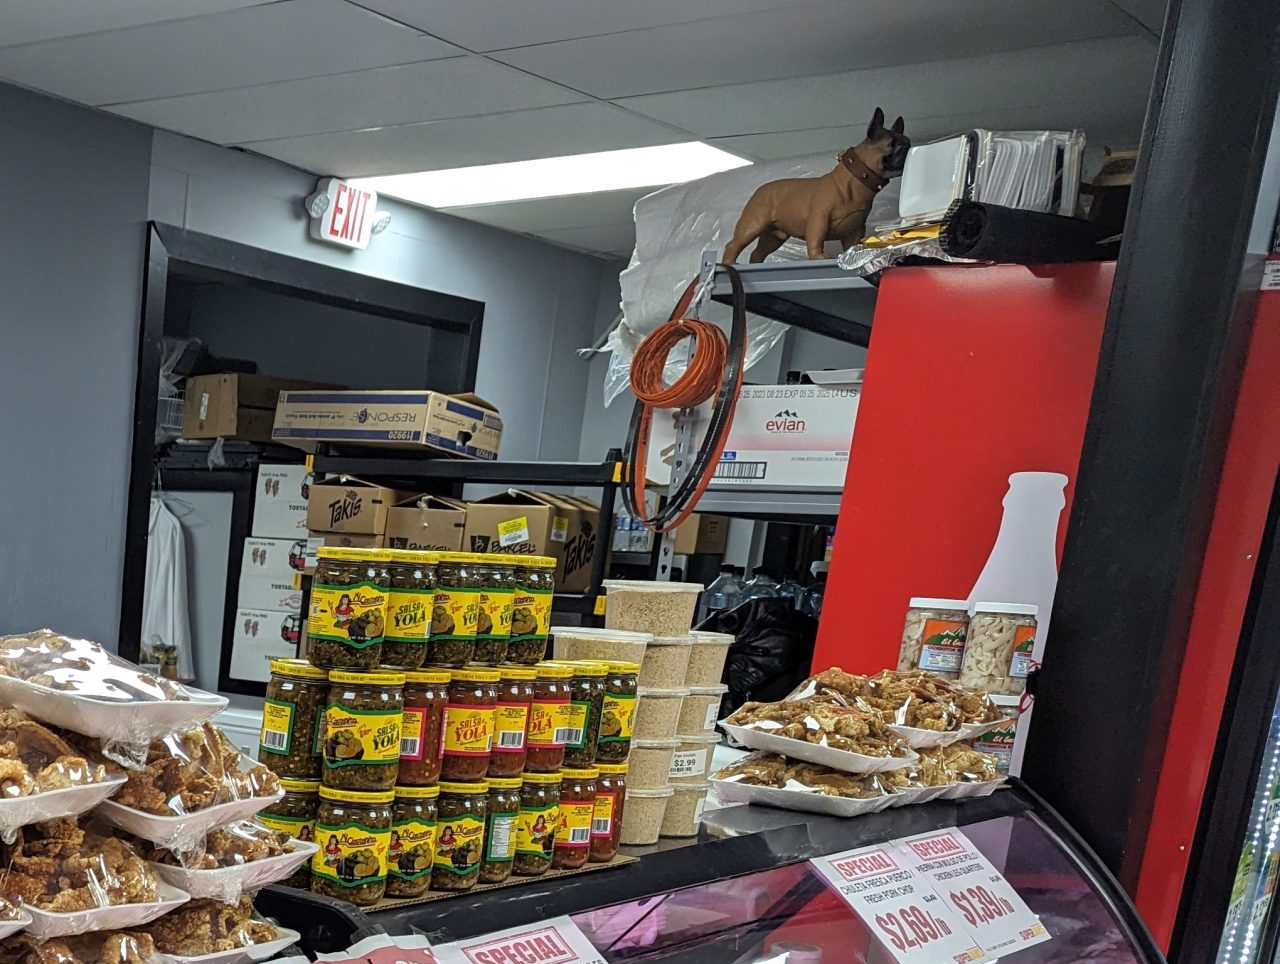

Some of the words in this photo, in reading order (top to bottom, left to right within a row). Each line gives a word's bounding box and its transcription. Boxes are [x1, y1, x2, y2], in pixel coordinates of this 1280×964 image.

[328, 184, 371, 242] EXIT
[784, 390, 798, 398] EXP
[354, 408, 417, 424] RESPONSE
[766, 418, 806, 431] evian
[388, 431, 412, 440] 19920
[329, 497, 363, 528] Takis
[563, 533, 596, 583] Takis
[399, 603, 421, 614] SALSA
[394, 611, 426, 627] YOLA
[377, 723, 396, 737] SALSA
[460, 718, 481, 733] SALSA
[372, 732, 400, 749] YOLA
[455, 727, 487, 743] YOLA
[674, 759, 696, 767] $2.99
[913, 837, 960, 857] SPECIAL
[837, 852, 892, 876] SPECIAL
[840, 881, 868, 896] CHULETA
[865, 876, 890, 890] FRESCA
[887, 870, 913, 884] PUERCO
[864, 891, 885, 904] FRESH
[883, 888, 902, 900] PORK
[898, 885, 915, 897] CHOP
[875, 905, 952, 953] $2,69/lb
